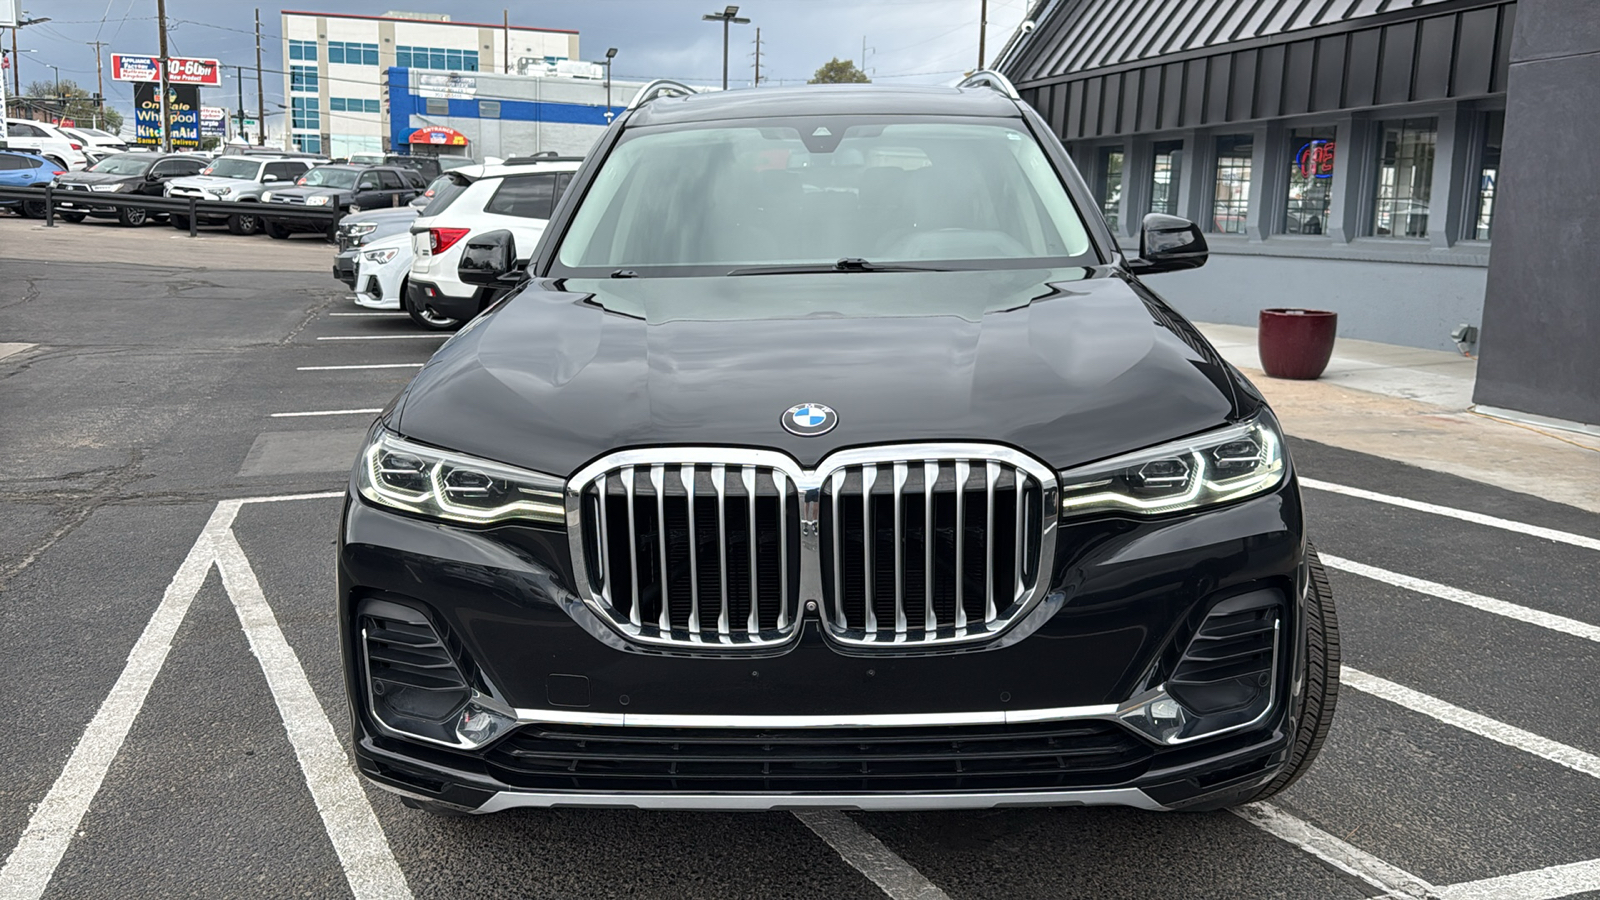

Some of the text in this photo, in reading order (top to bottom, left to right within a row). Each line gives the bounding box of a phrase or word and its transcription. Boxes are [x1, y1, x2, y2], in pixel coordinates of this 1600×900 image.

[141, 101, 190, 111] On ale
[137, 110, 196, 124] Whipool
[137, 125, 197, 139] KitcnAid
[422, 126, 454, 135] ENTRANCE
[172, 139, 199, 147] Delivery
[1301, 142, 1335, 178] OPE
[787, 403, 832, 413] BMW
